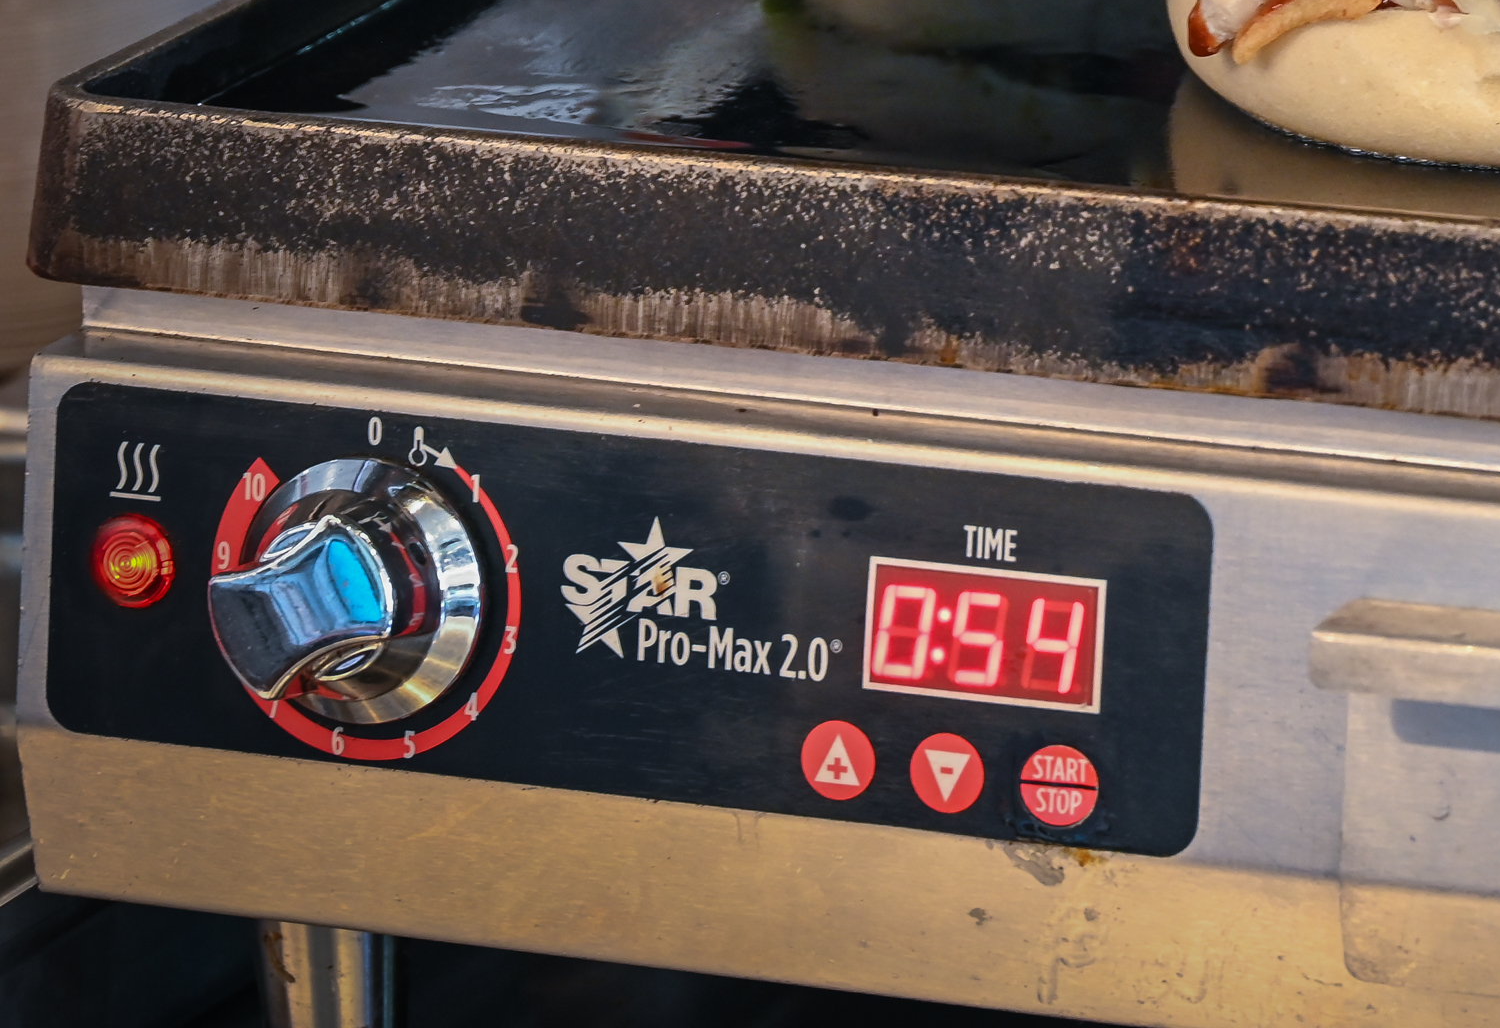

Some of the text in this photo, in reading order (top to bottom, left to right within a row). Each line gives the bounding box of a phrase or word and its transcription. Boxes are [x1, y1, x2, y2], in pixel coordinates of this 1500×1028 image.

[367, 416, 384, 446] 0
[242, 472, 267, 502] 10
[470, 474, 480, 503] 1
[217, 541, 230, 569] 9
[505, 543, 519, 574] 2
[963, 524, 1018, 563] TIME
[503, 625, 518, 655] 3
[637, 618, 773, 675] Pro-Max
[871, 583, 1085, 694] 0:54
[463, 691, 479, 722] 4
[331, 726, 345, 756] 6
[402, 730, 416, 759] 5
[1032, 754, 1090, 783] START
[1035, 787, 1083, 815] STOP
